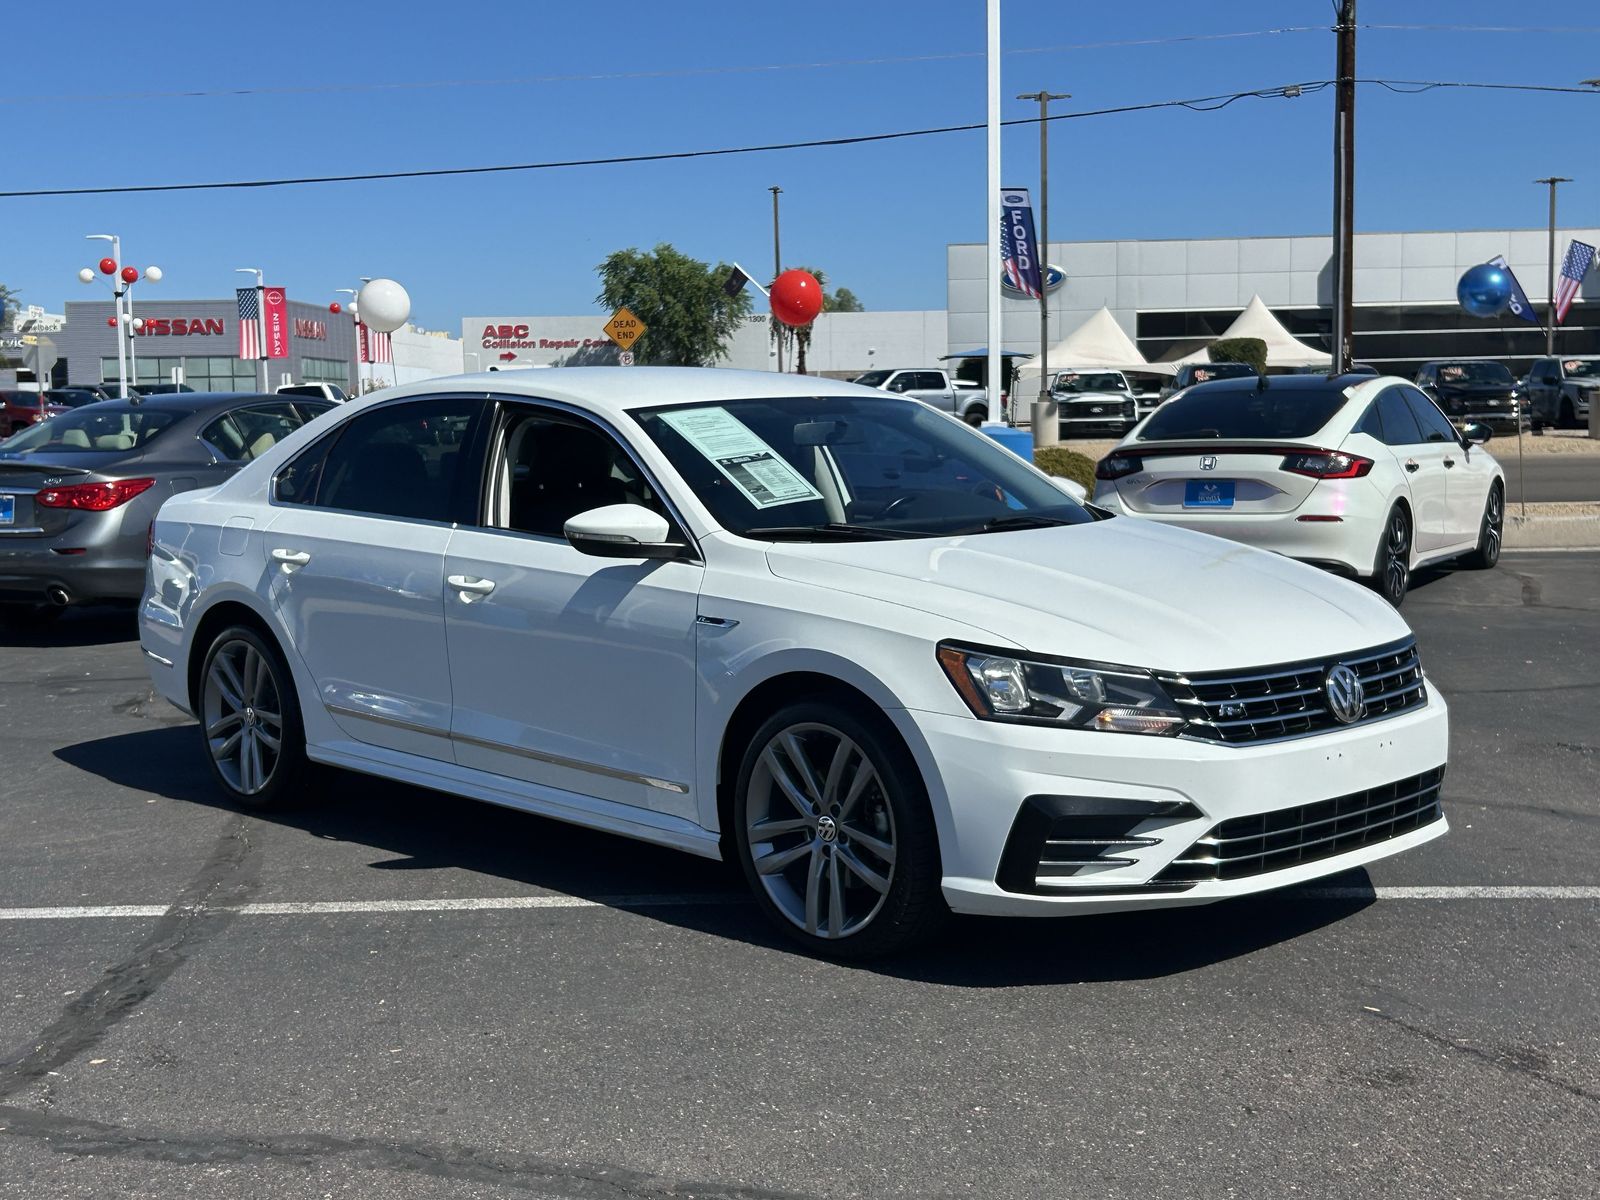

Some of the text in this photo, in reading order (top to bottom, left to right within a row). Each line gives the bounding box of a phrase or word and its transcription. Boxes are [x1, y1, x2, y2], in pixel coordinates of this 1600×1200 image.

[1011, 210, 1031, 270] FORD
[613, 320, 636, 328] DEAD
[482, 325, 529, 339] ABC
[617, 331, 635, 339] END
[482, 338, 617, 350] Collision Repair Cent
